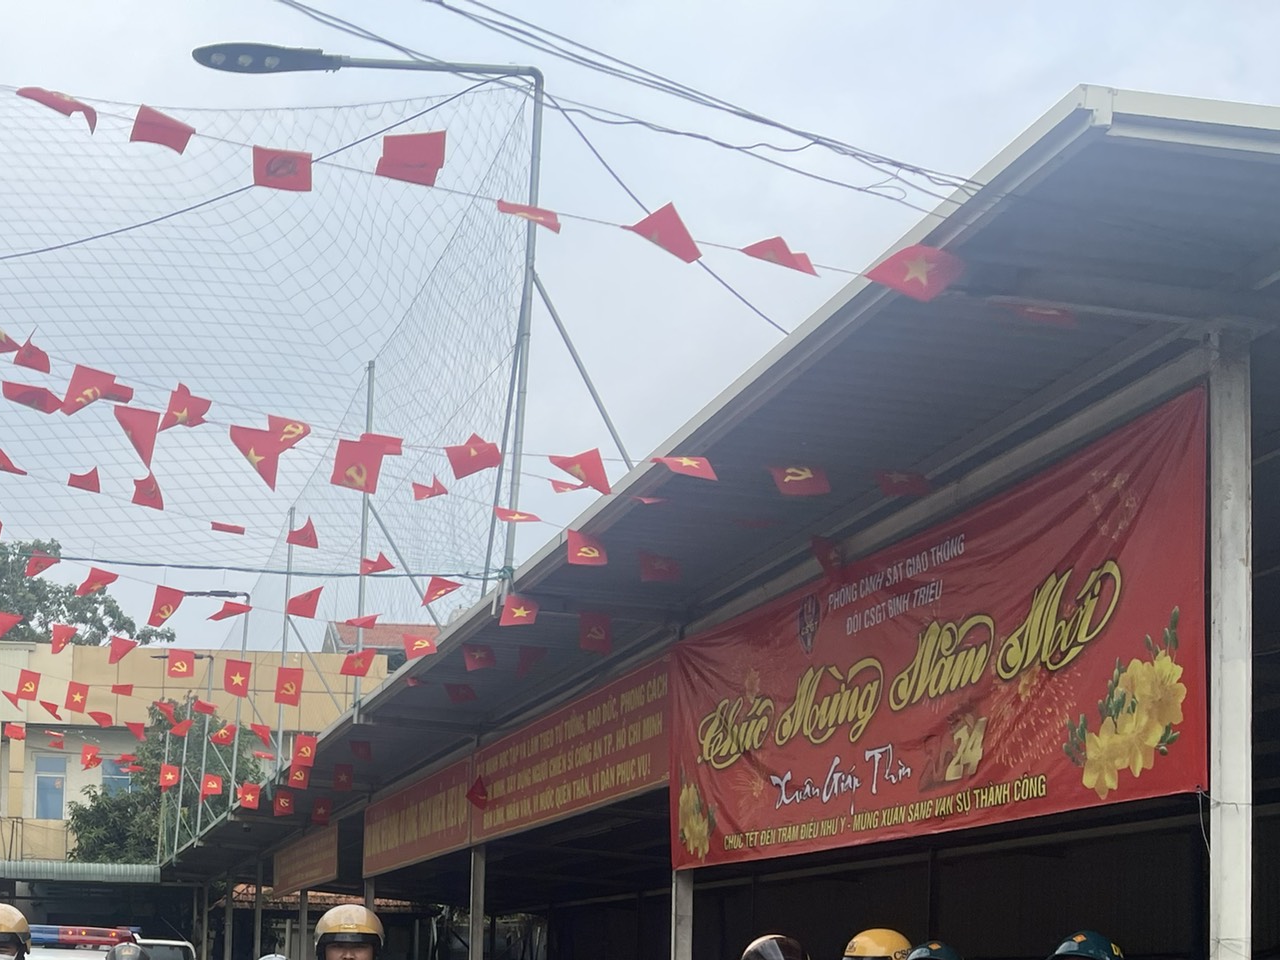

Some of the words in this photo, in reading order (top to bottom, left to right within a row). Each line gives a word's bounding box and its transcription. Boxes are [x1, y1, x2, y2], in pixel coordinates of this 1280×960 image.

[828, 582, 857, 611] PHÒNG
[886, 561, 903, 587] SÁT
[906, 551, 929, 577] GIAO
[930, 534, 965, 567] THÔNG
[846, 610, 862, 636] ĐỘI
[864, 603, 886, 628] CSGT
[888, 593, 910, 618] BÌNH
[913, 579, 942, 607] TRIỆU
[697, 694, 775, 769] Chúc
[775, 658, 884, 744] Mừng
[889, 615, 994, 711] Năm
[996, 560, 1121, 679] Mới
[620, 685, 645, 714] PHONG
[646, 672, 667, 702] CÁCH
[642, 712, 662, 741] MINH
[617, 756, 635, 786] PHỤC
[770, 771, 820, 810] Xuân
[823, 757, 861, 816] Giáp
[865, 743, 912, 794] Thìn
[881, 807, 905, 827] XUÂN
[908, 801, 932, 821] SANG
[934, 795, 953, 820] VẠN
[956, 791, 971, 816] SỰ
[973, 782, 1010, 809] THÀNH
[1014, 773, 1046, 799] CÔNG
